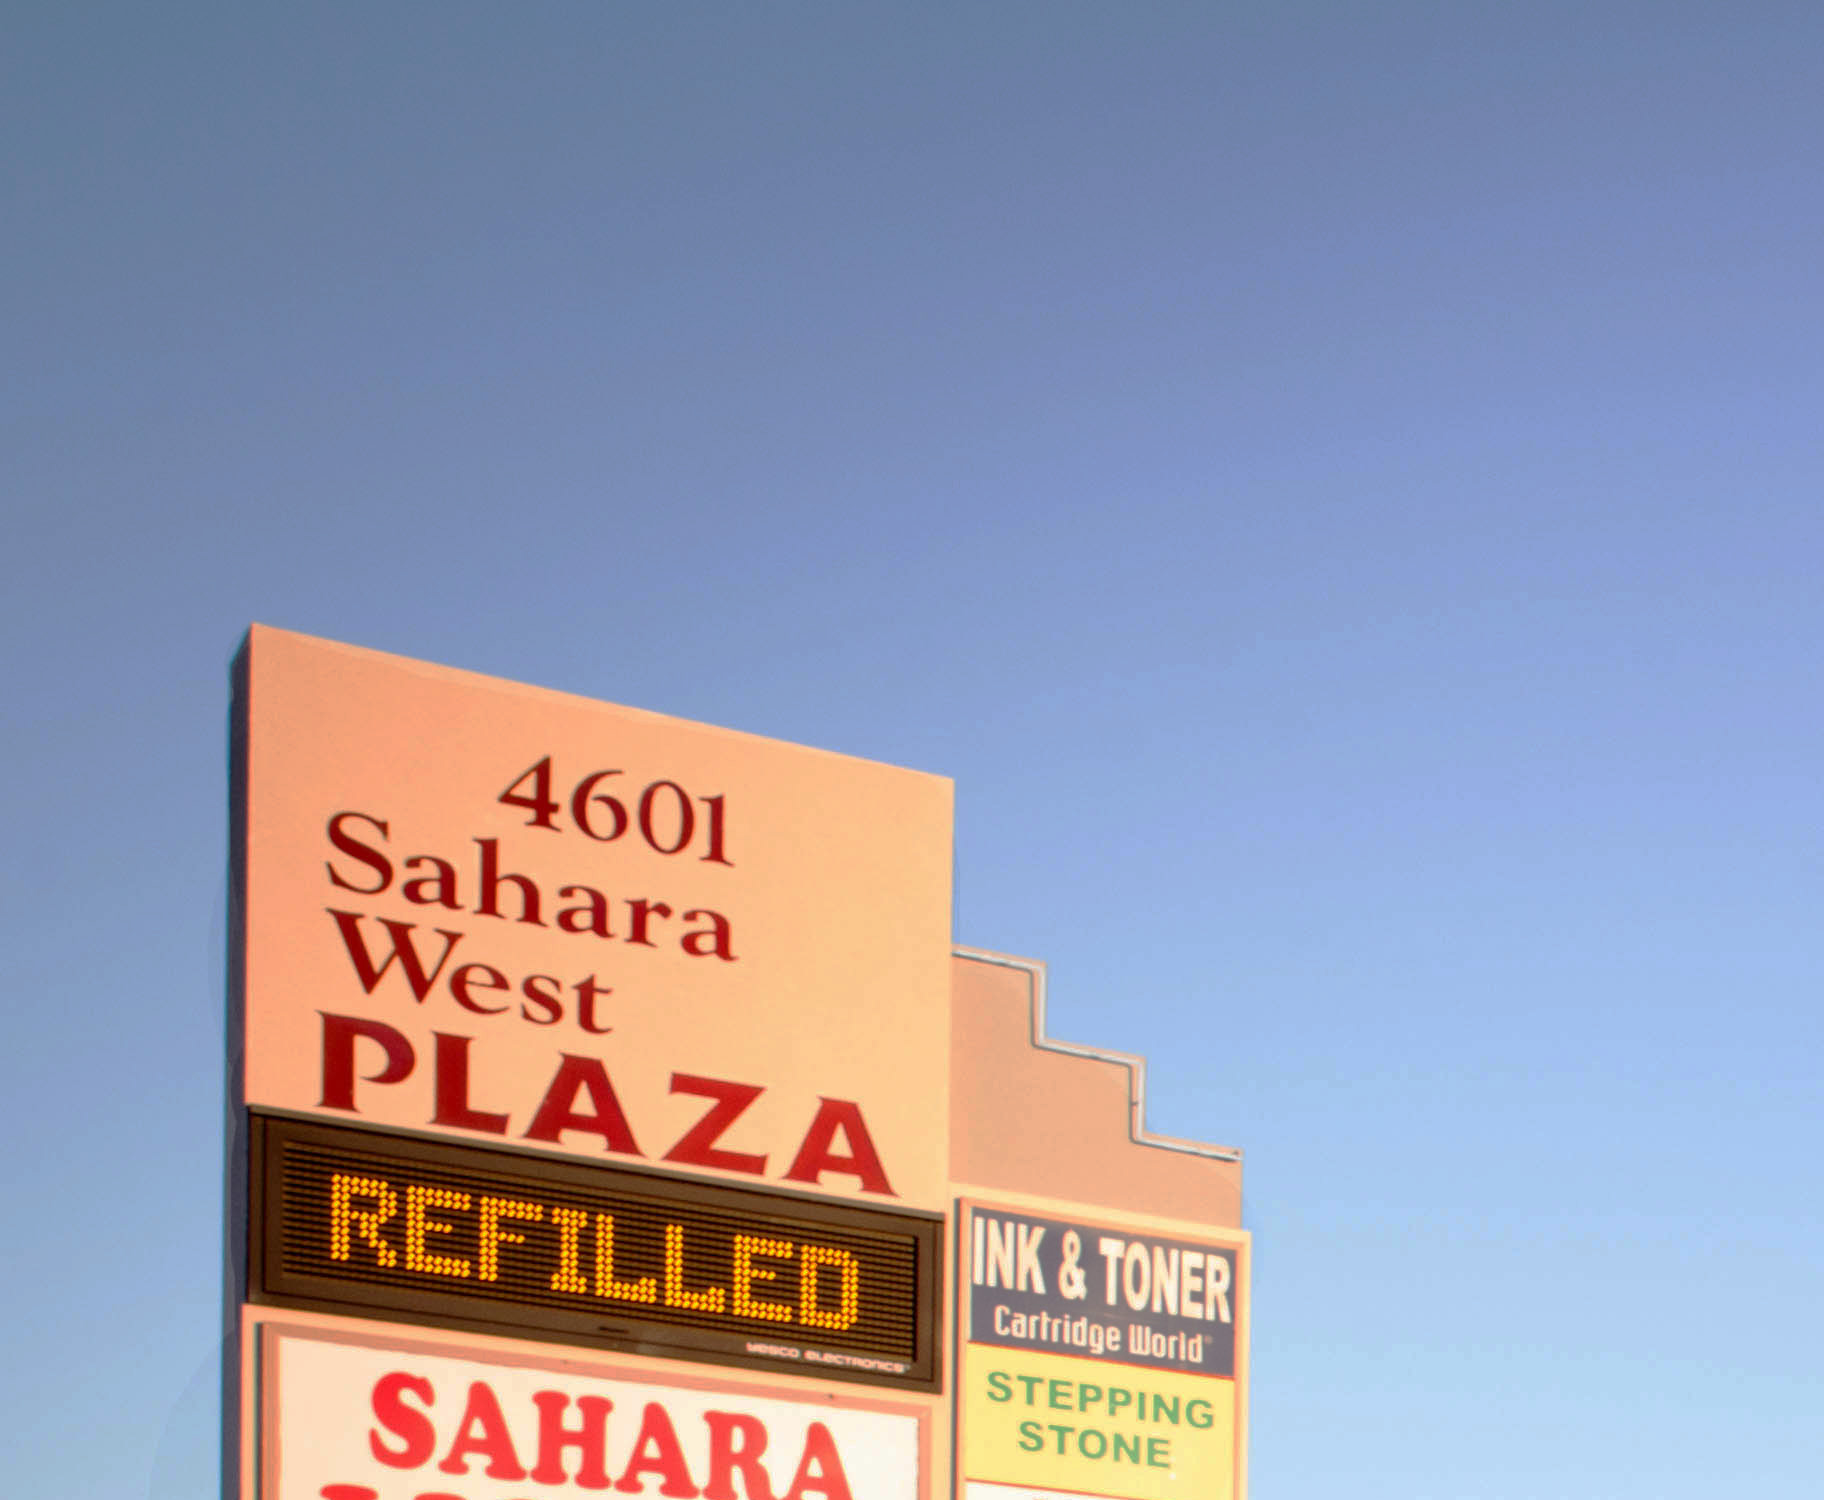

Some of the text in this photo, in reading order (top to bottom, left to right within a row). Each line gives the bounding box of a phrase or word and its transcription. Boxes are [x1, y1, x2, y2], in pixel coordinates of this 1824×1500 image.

[498, 755, 735, 867] 4601
[325, 811, 738, 961] Sahara
[325, 907, 614, 1034] West
[315, 1010, 899, 1197] PLAZA
[330, 1173, 859, 1330] REFILLED
[972, 1216, 1232, 1323] INK & TONER
[994, 1305, 1204, 1363] Cartridge World
[987, 1371, 1215, 1429] STEPPING
[1018, 1420, 1171, 1469] STONE
